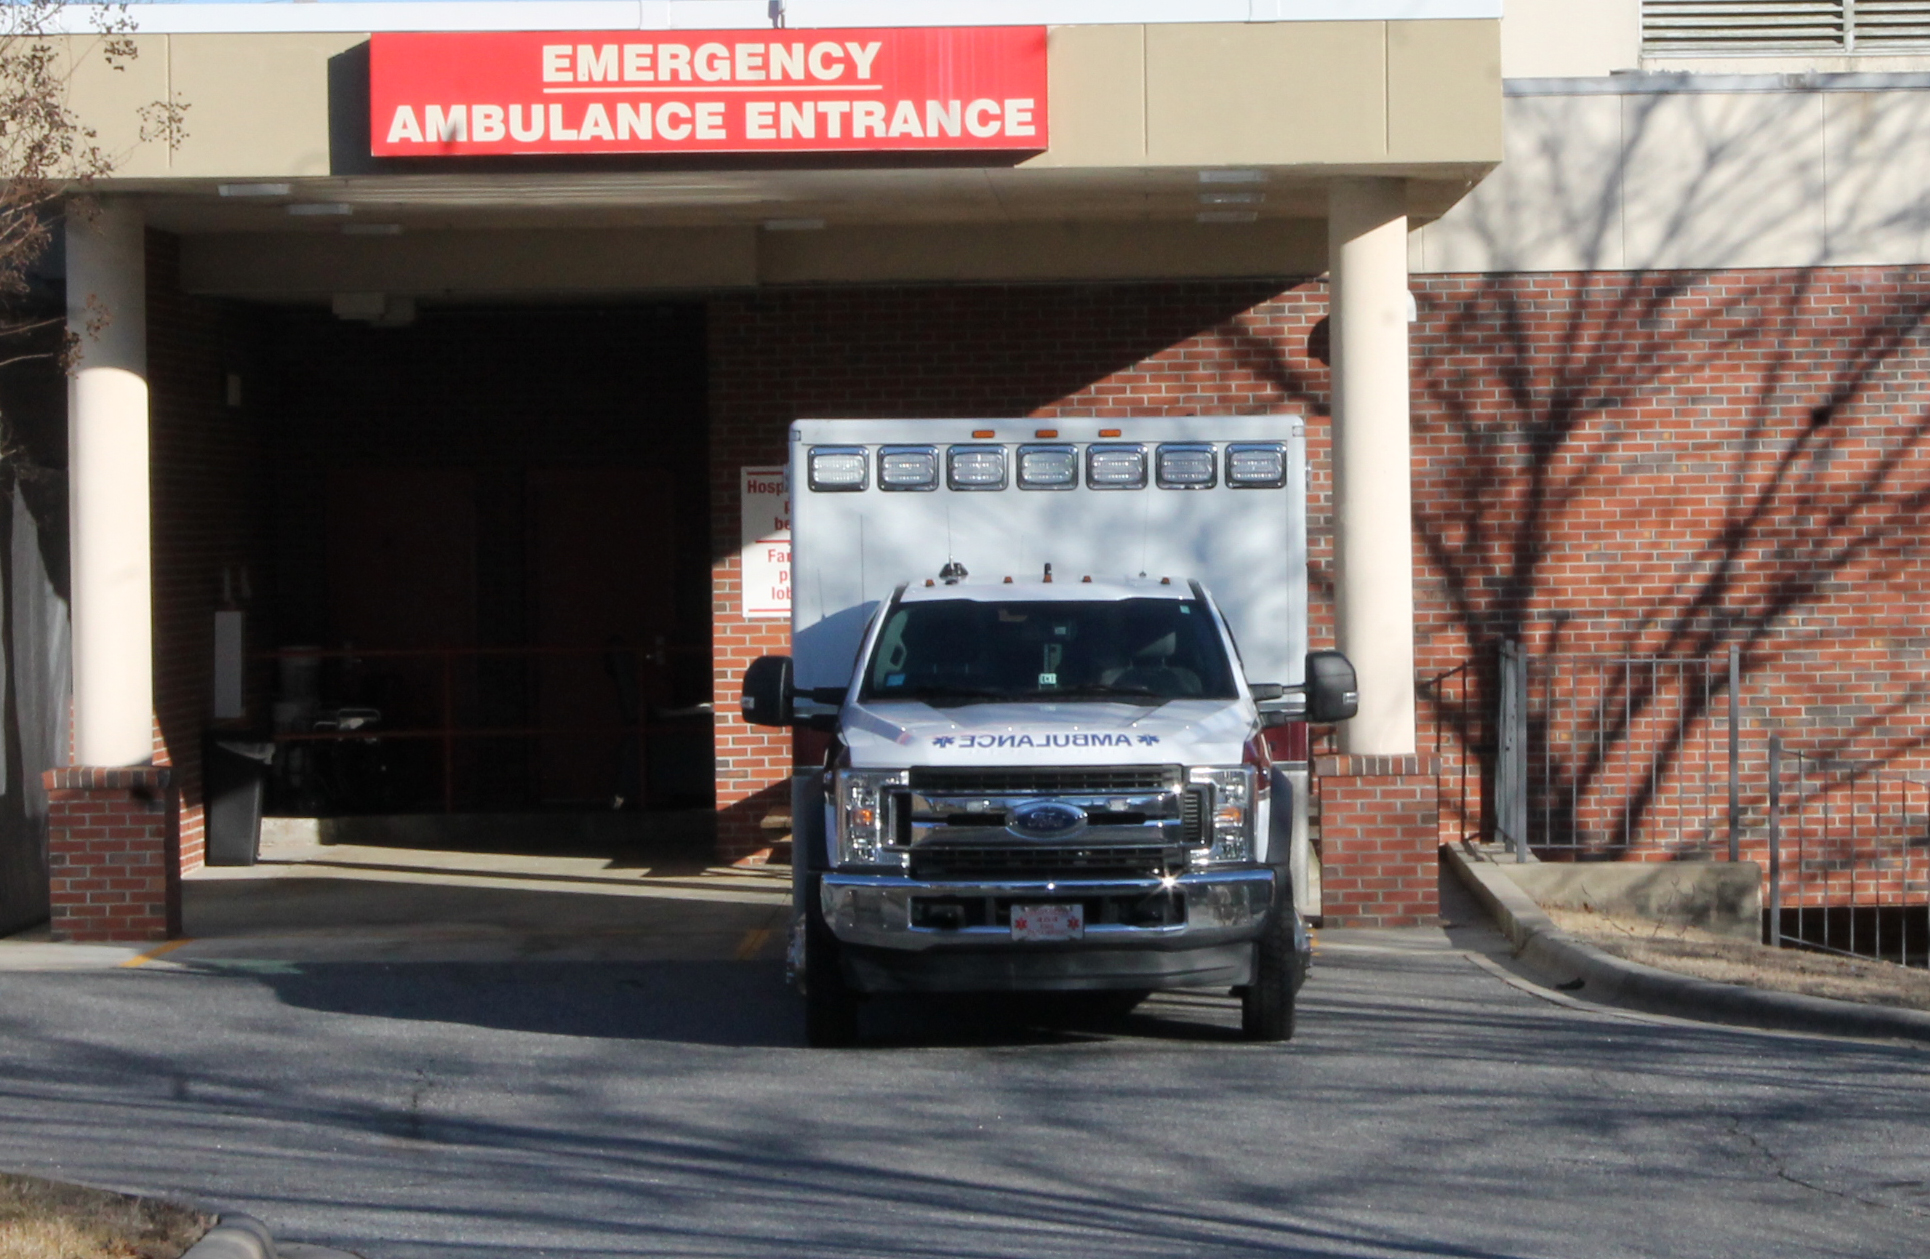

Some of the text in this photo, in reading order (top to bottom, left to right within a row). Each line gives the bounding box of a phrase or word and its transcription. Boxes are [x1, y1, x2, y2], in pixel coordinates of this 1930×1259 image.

[543, 42, 882, 82] EMERGENCY
[386, 98, 1036, 142] AMBULANCE ENTRANCE
